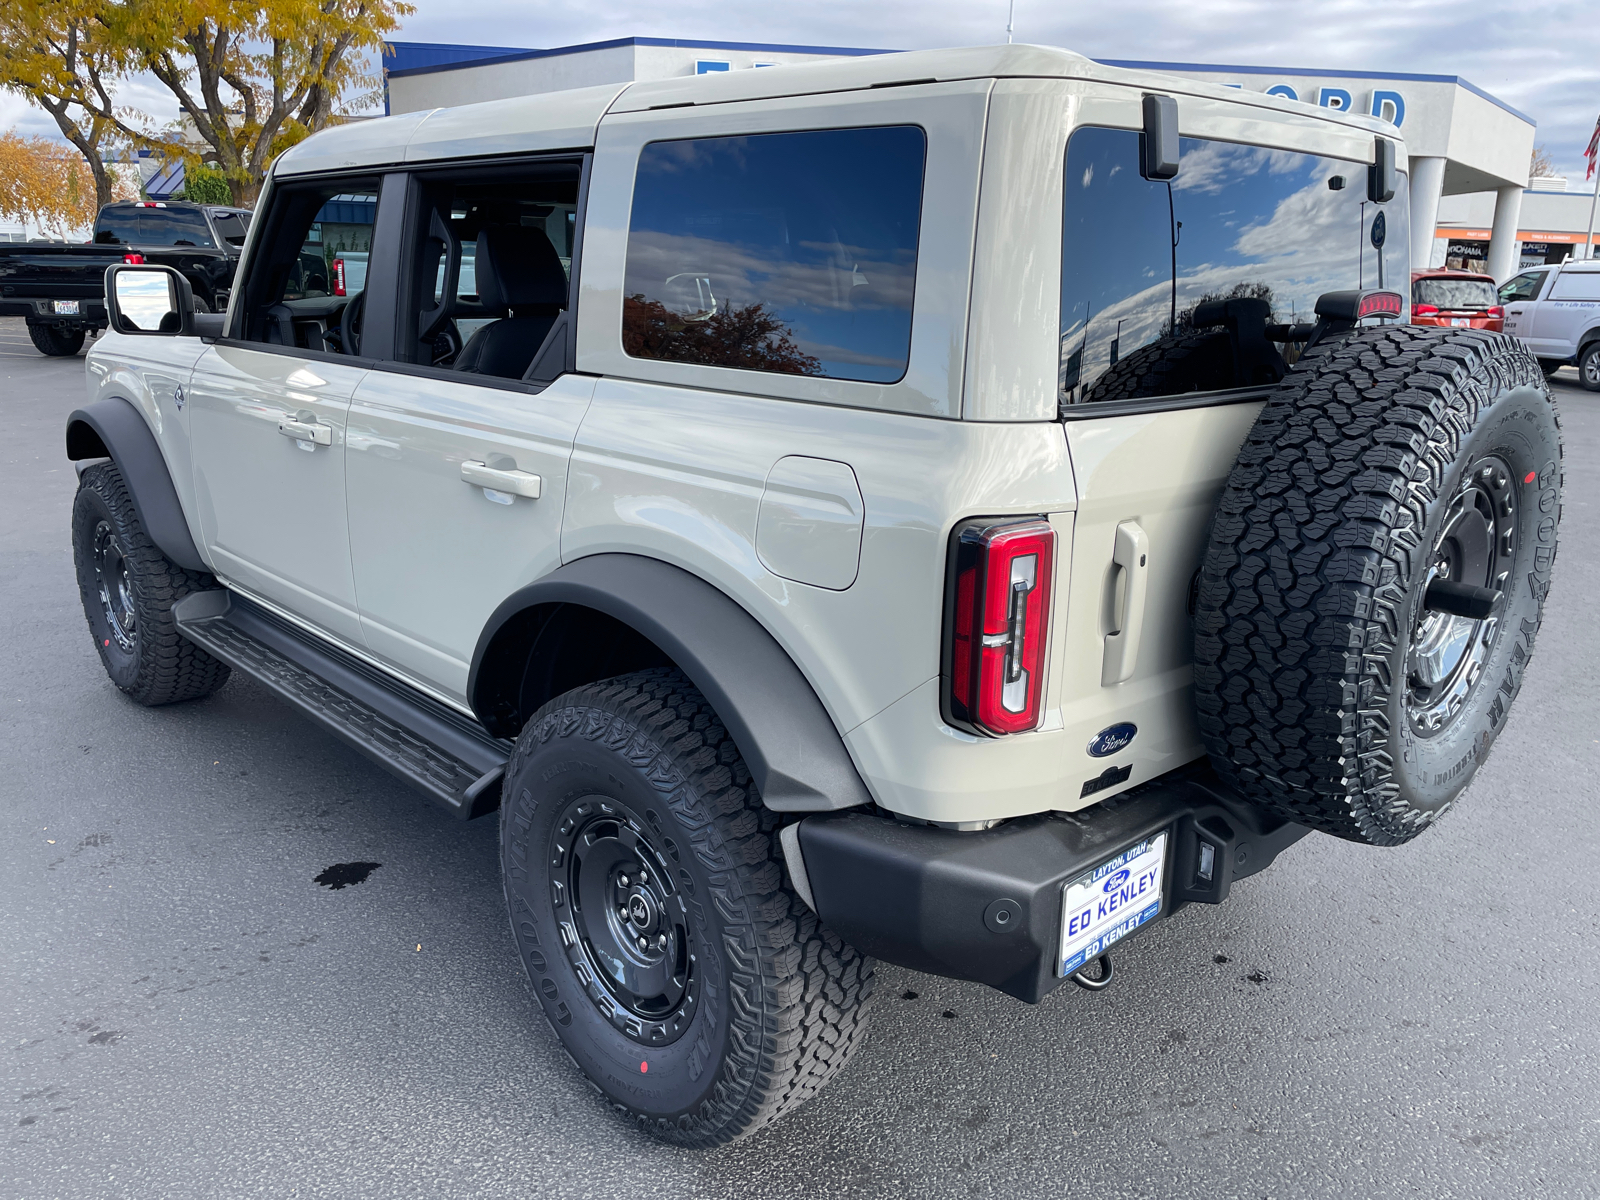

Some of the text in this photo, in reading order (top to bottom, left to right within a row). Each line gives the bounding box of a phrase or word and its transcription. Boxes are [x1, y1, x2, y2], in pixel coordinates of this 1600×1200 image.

[1092, 841, 1147, 882] LAYTON, UTAH
[1068, 908, 1091, 937] ED
[1097, 867, 1158, 921] KENLEY
[1084, 941, 1100, 960] ED
[1101, 913, 1143, 949] KENLEY
